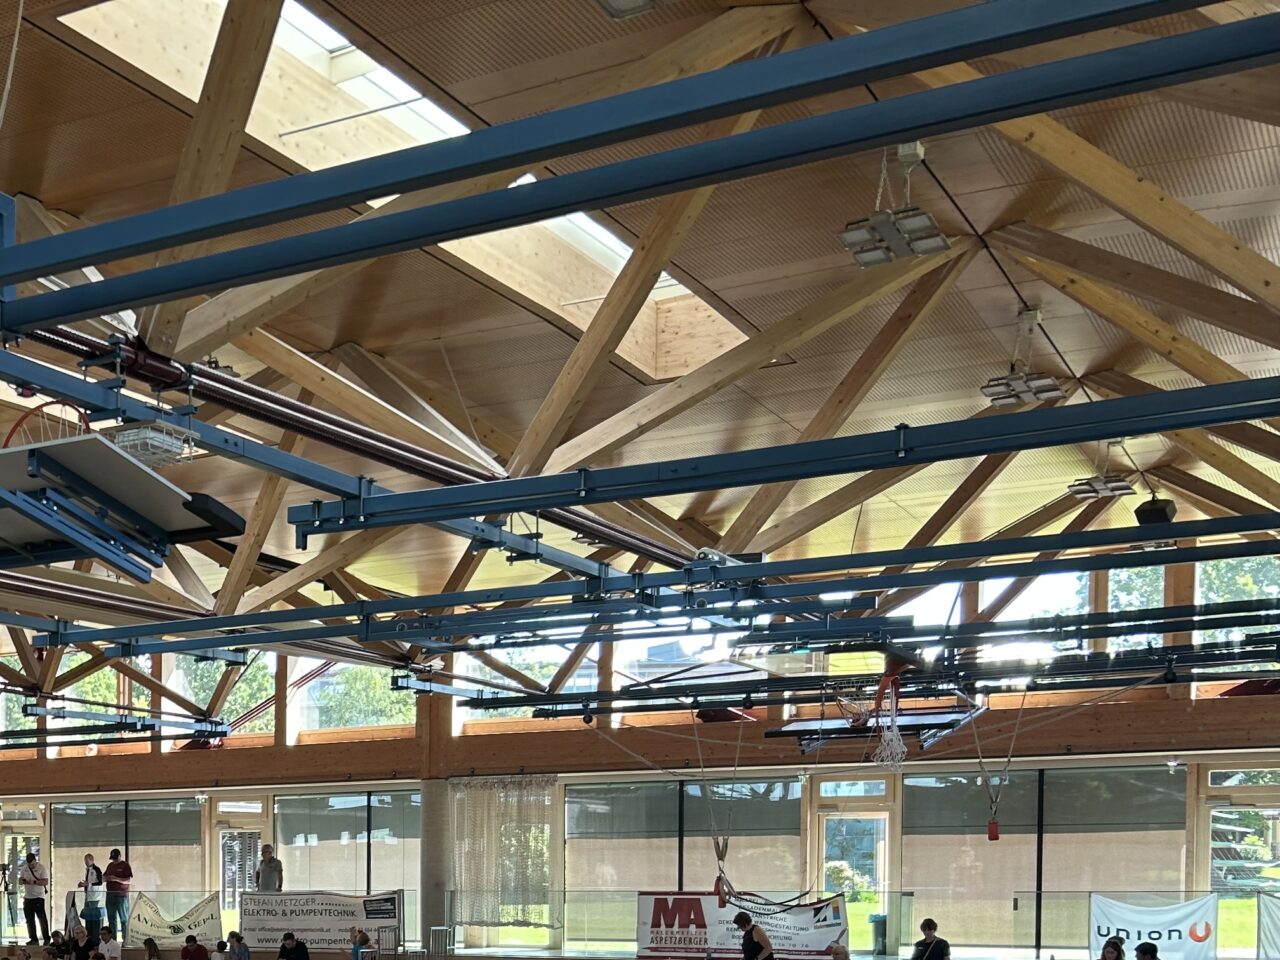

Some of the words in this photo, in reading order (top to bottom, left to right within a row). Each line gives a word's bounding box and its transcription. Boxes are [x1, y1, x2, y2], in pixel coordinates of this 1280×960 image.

[243, 898, 273, 907] STEFAN
[276, 897, 316, 907] METZGER
[243, 908, 279, 917] ELEKTRO-
[281, 909, 288, 917] &
[290, 909, 357, 918] PUMPENTECHNIK
[650, 897, 708, 929] MA
[1096, 924, 1183, 941] union
[649, 936, 709, 946] ASPETZBERGER
